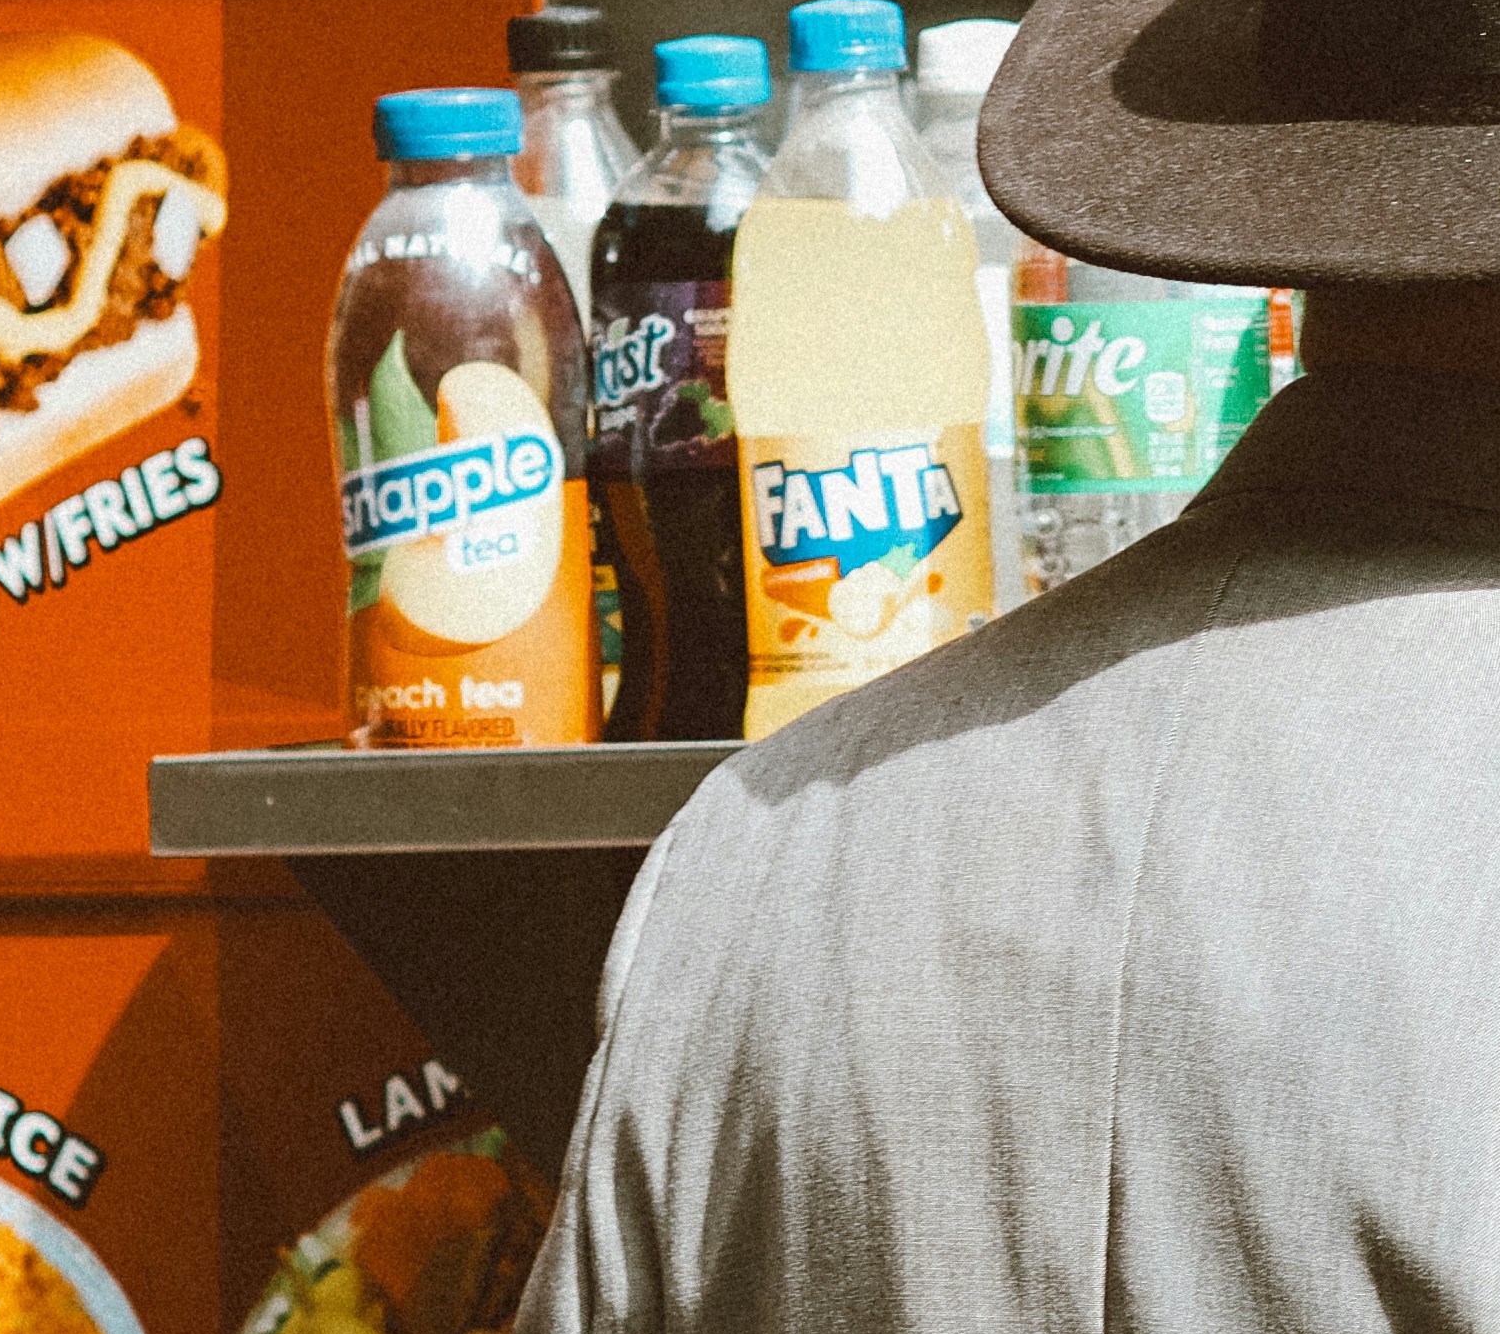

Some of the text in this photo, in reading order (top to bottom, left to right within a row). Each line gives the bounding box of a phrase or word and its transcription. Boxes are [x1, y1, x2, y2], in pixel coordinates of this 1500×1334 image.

[753, 443, 962, 551] FANTA
[463, 533, 519, 566] tea
[459, 674, 524, 709] tea
